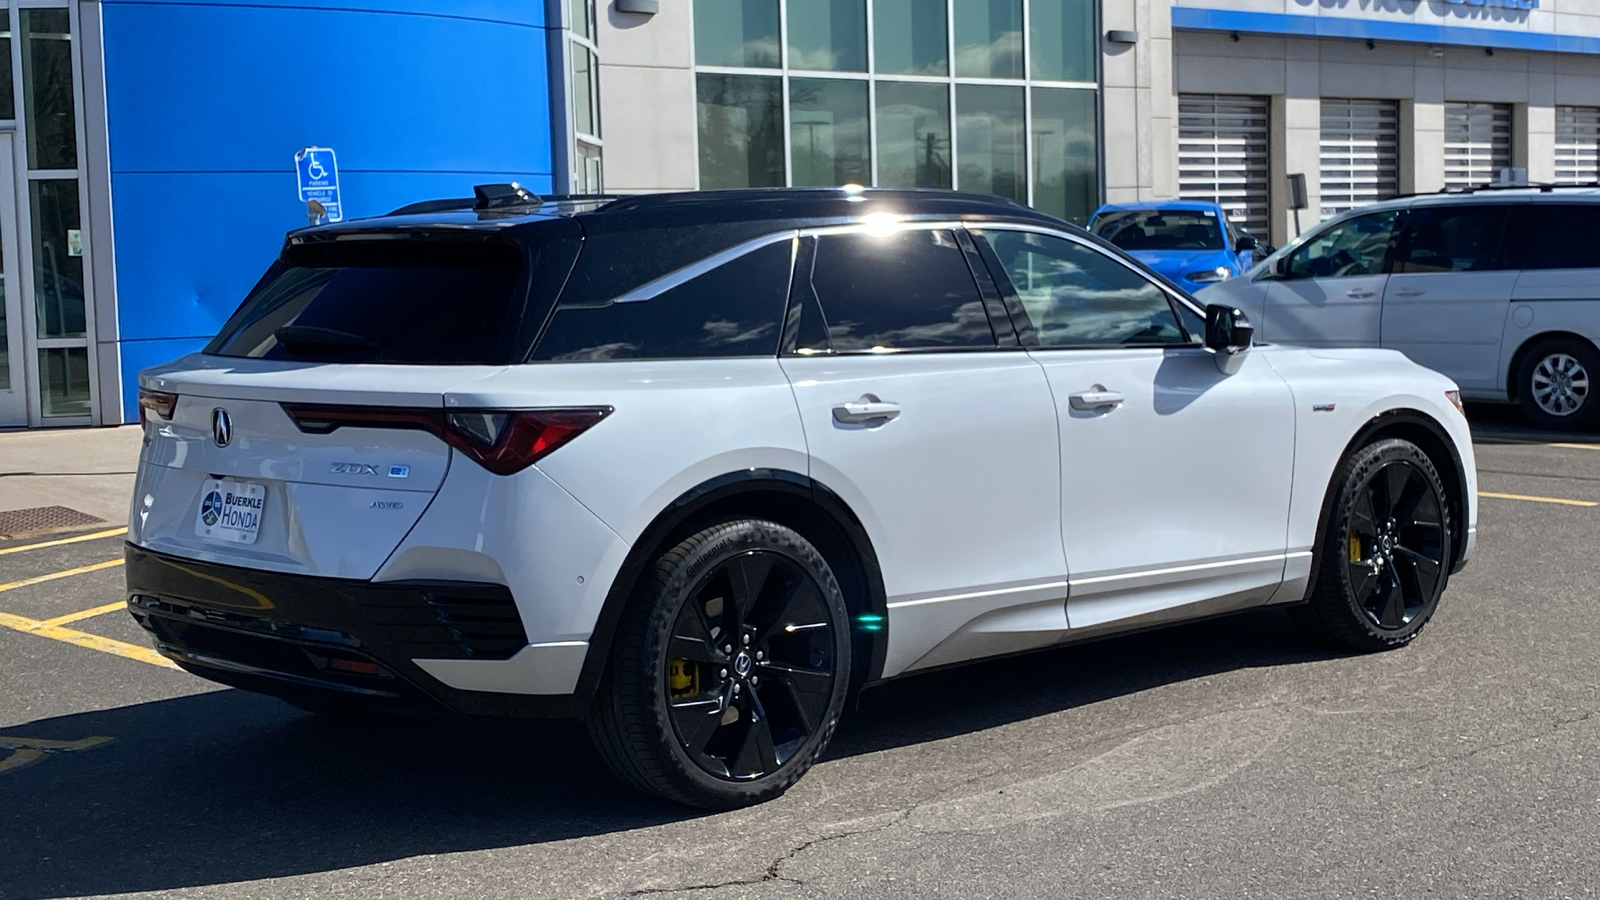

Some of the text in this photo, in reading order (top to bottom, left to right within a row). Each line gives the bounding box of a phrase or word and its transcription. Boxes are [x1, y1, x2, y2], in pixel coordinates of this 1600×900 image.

[329, 462, 380, 475] ZDX
[225, 492, 262, 508] BUERKLE
[221, 505, 258, 530] HONDA
[686, 539, 727, 577] Continental
